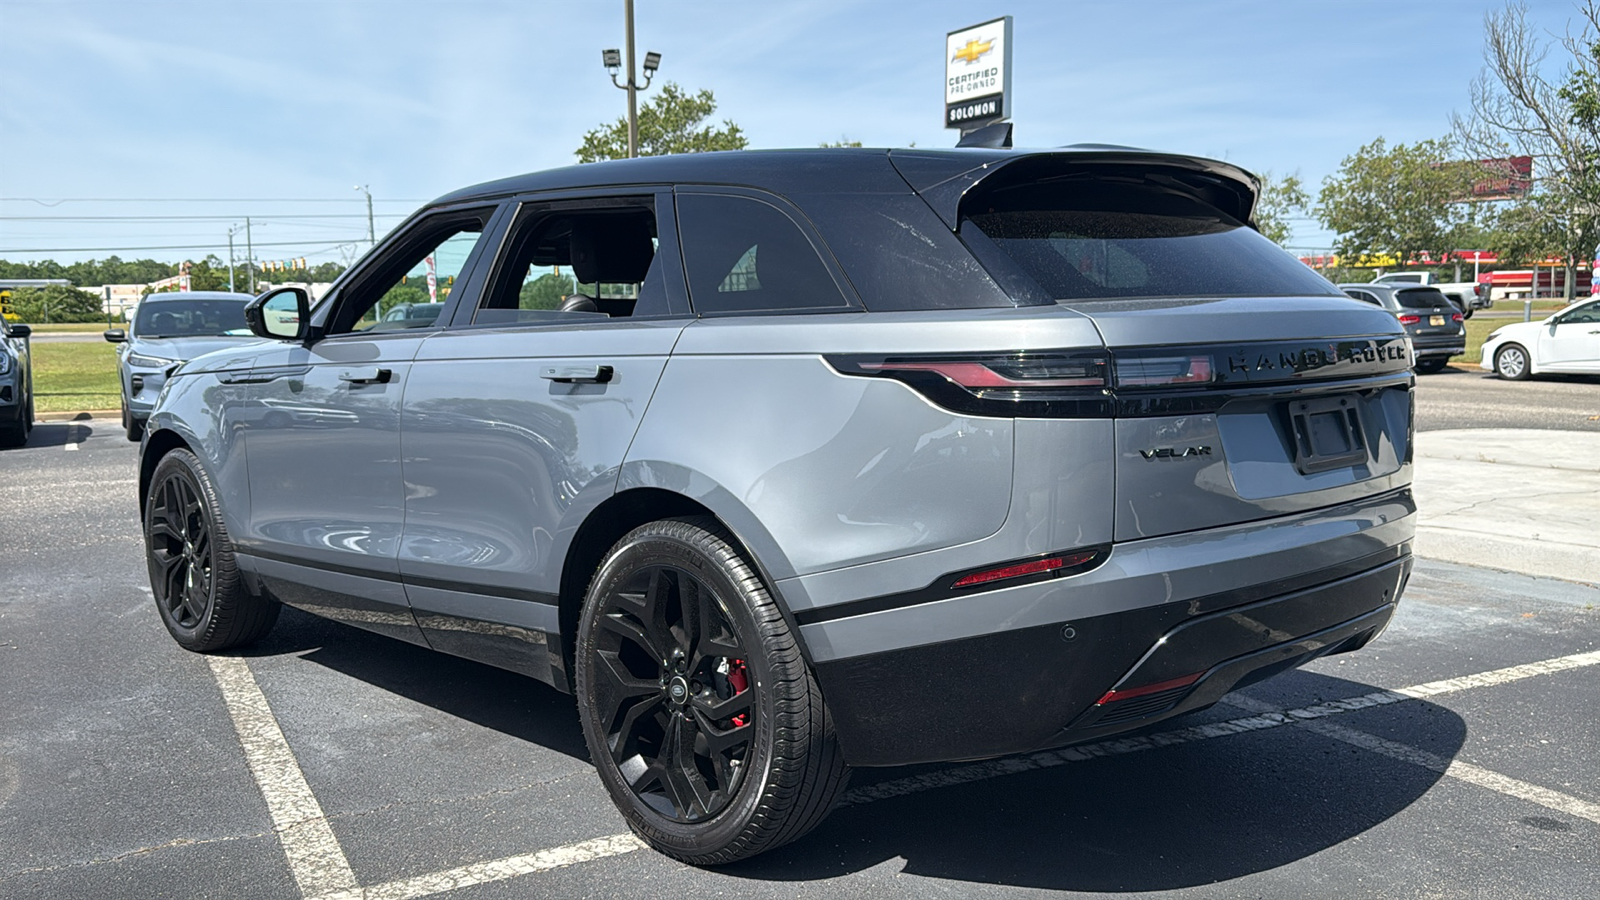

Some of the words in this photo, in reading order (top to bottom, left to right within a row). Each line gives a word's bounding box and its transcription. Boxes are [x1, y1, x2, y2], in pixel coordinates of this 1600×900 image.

[949, 67, 998, 86] CERTIFIED
[950, 101, 996, 121] SOLOMON
[1349, 346, 1405, 364] ROVER
[1139, 446, 1211, 459] VELAR
